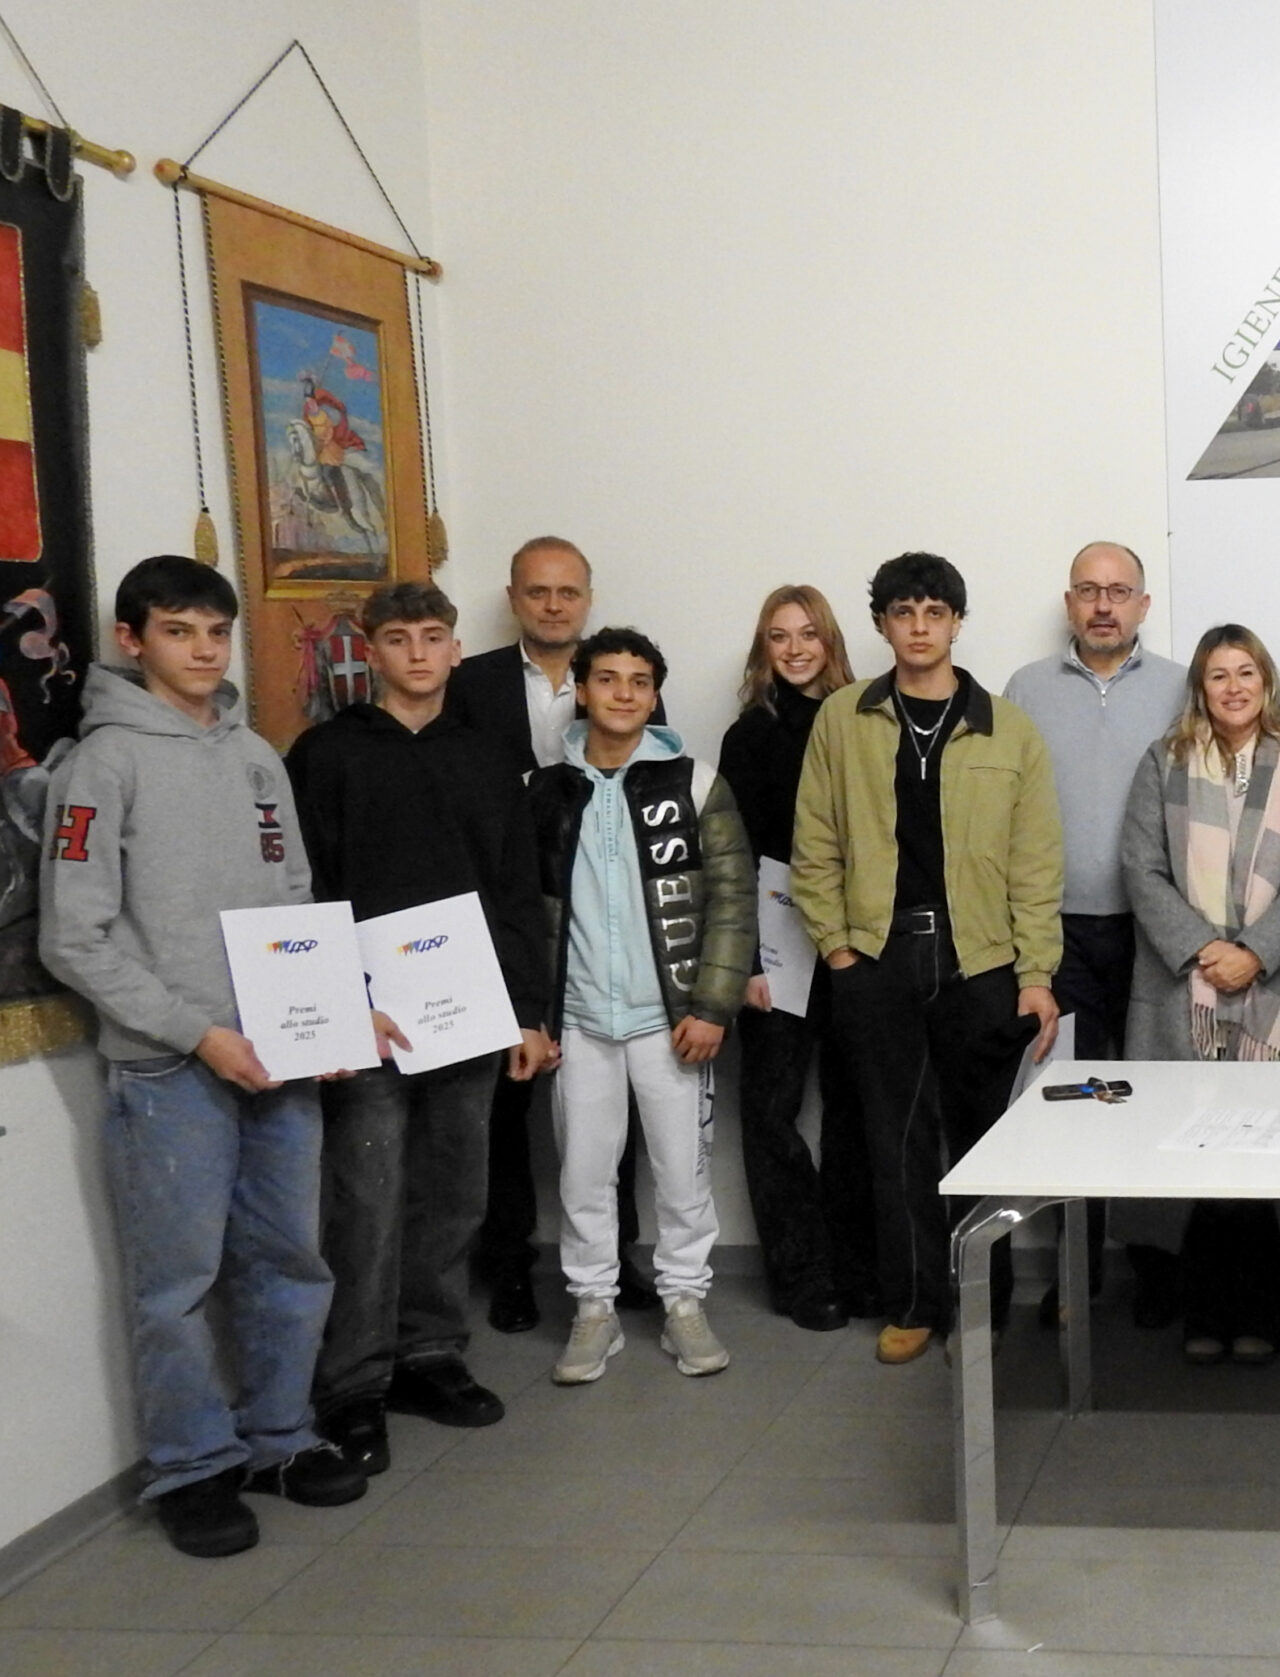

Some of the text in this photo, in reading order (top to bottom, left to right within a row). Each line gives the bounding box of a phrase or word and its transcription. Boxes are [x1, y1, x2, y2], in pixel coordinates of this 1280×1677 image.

[50, 804, 97, 862] H
[641, 799, 698, 993] GUESS
[288, 1003, 317, 1015] Premi
[424, 995, 453, 1011] Premi
[432, 1020, 454, 1034] 2025
[294, 1030, 316, 1042] 2025
